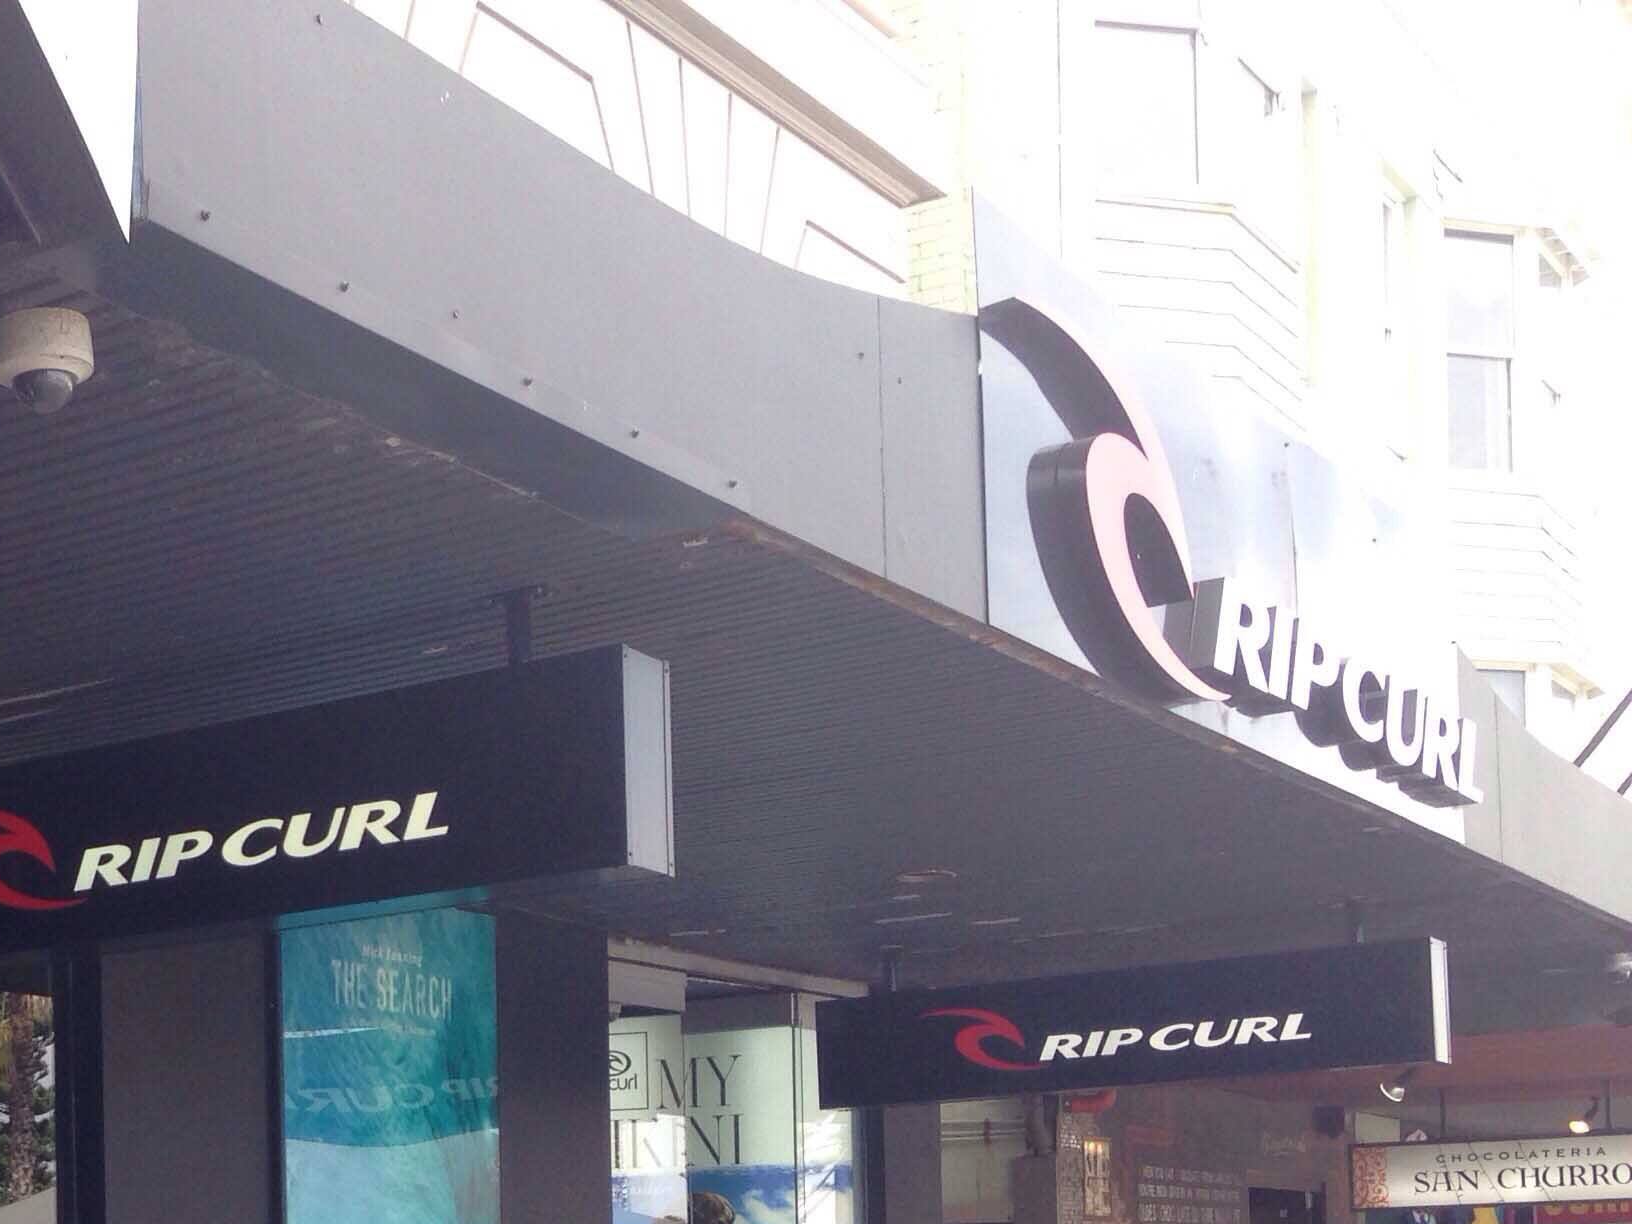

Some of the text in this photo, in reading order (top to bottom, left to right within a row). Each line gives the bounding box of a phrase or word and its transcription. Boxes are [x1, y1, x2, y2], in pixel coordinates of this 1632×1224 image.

[1212, 576, 1484, 804] RIP CURL
[73, 791, 450, 893] RIP CURL
[331, 959, 453, 1023] THE SEARCH
[1039, 1012, 1313, 1061] RIP CURL
[656, 1053, 742, 1109] MY
[1414, 1161, 1632, 1193] SAN CHURRO
[1435, 1146, 1607, 1164] CHOCOLATERIA
